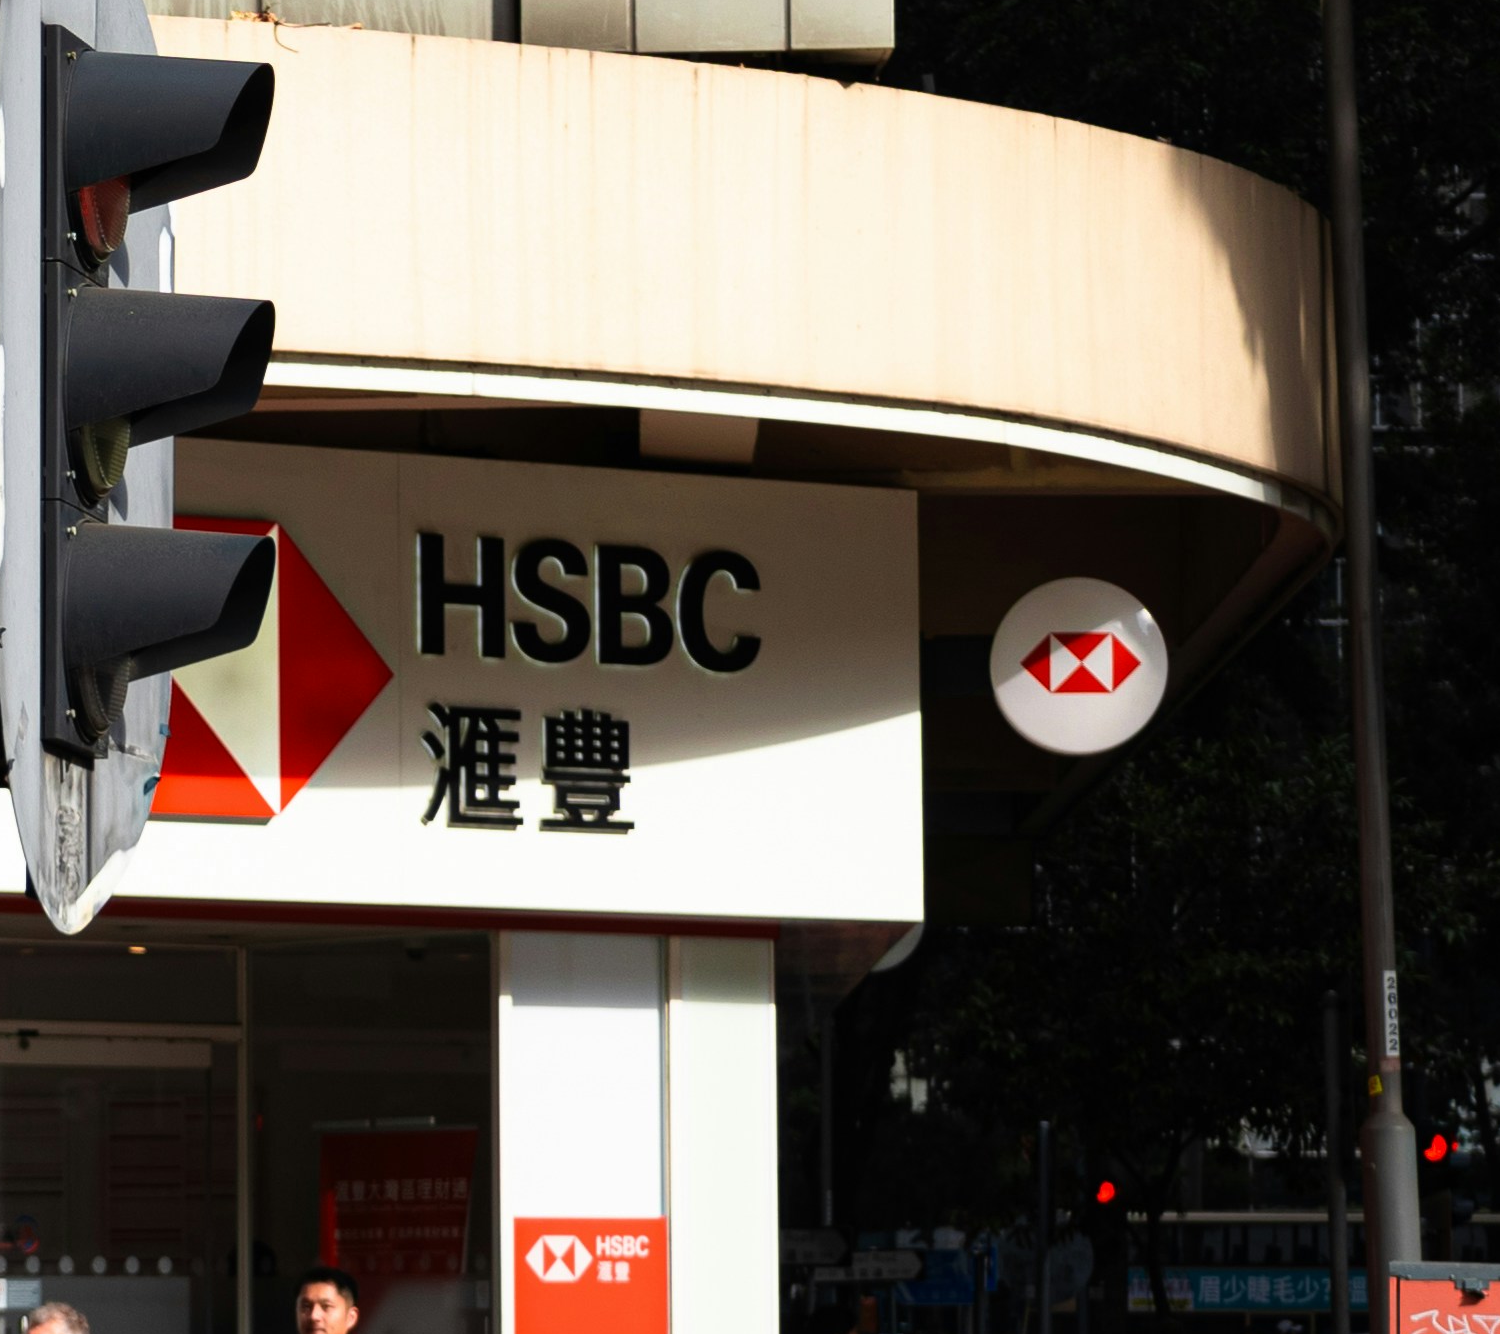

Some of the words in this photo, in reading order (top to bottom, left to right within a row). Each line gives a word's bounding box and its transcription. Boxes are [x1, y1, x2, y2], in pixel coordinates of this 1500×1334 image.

[416, 527, 762, 673] HSBC
[421, 701, 635, 833] 滙豐
[1386, 976, 1399, 1051] 26022
[595, 1234, 650, 1257] HSBC
